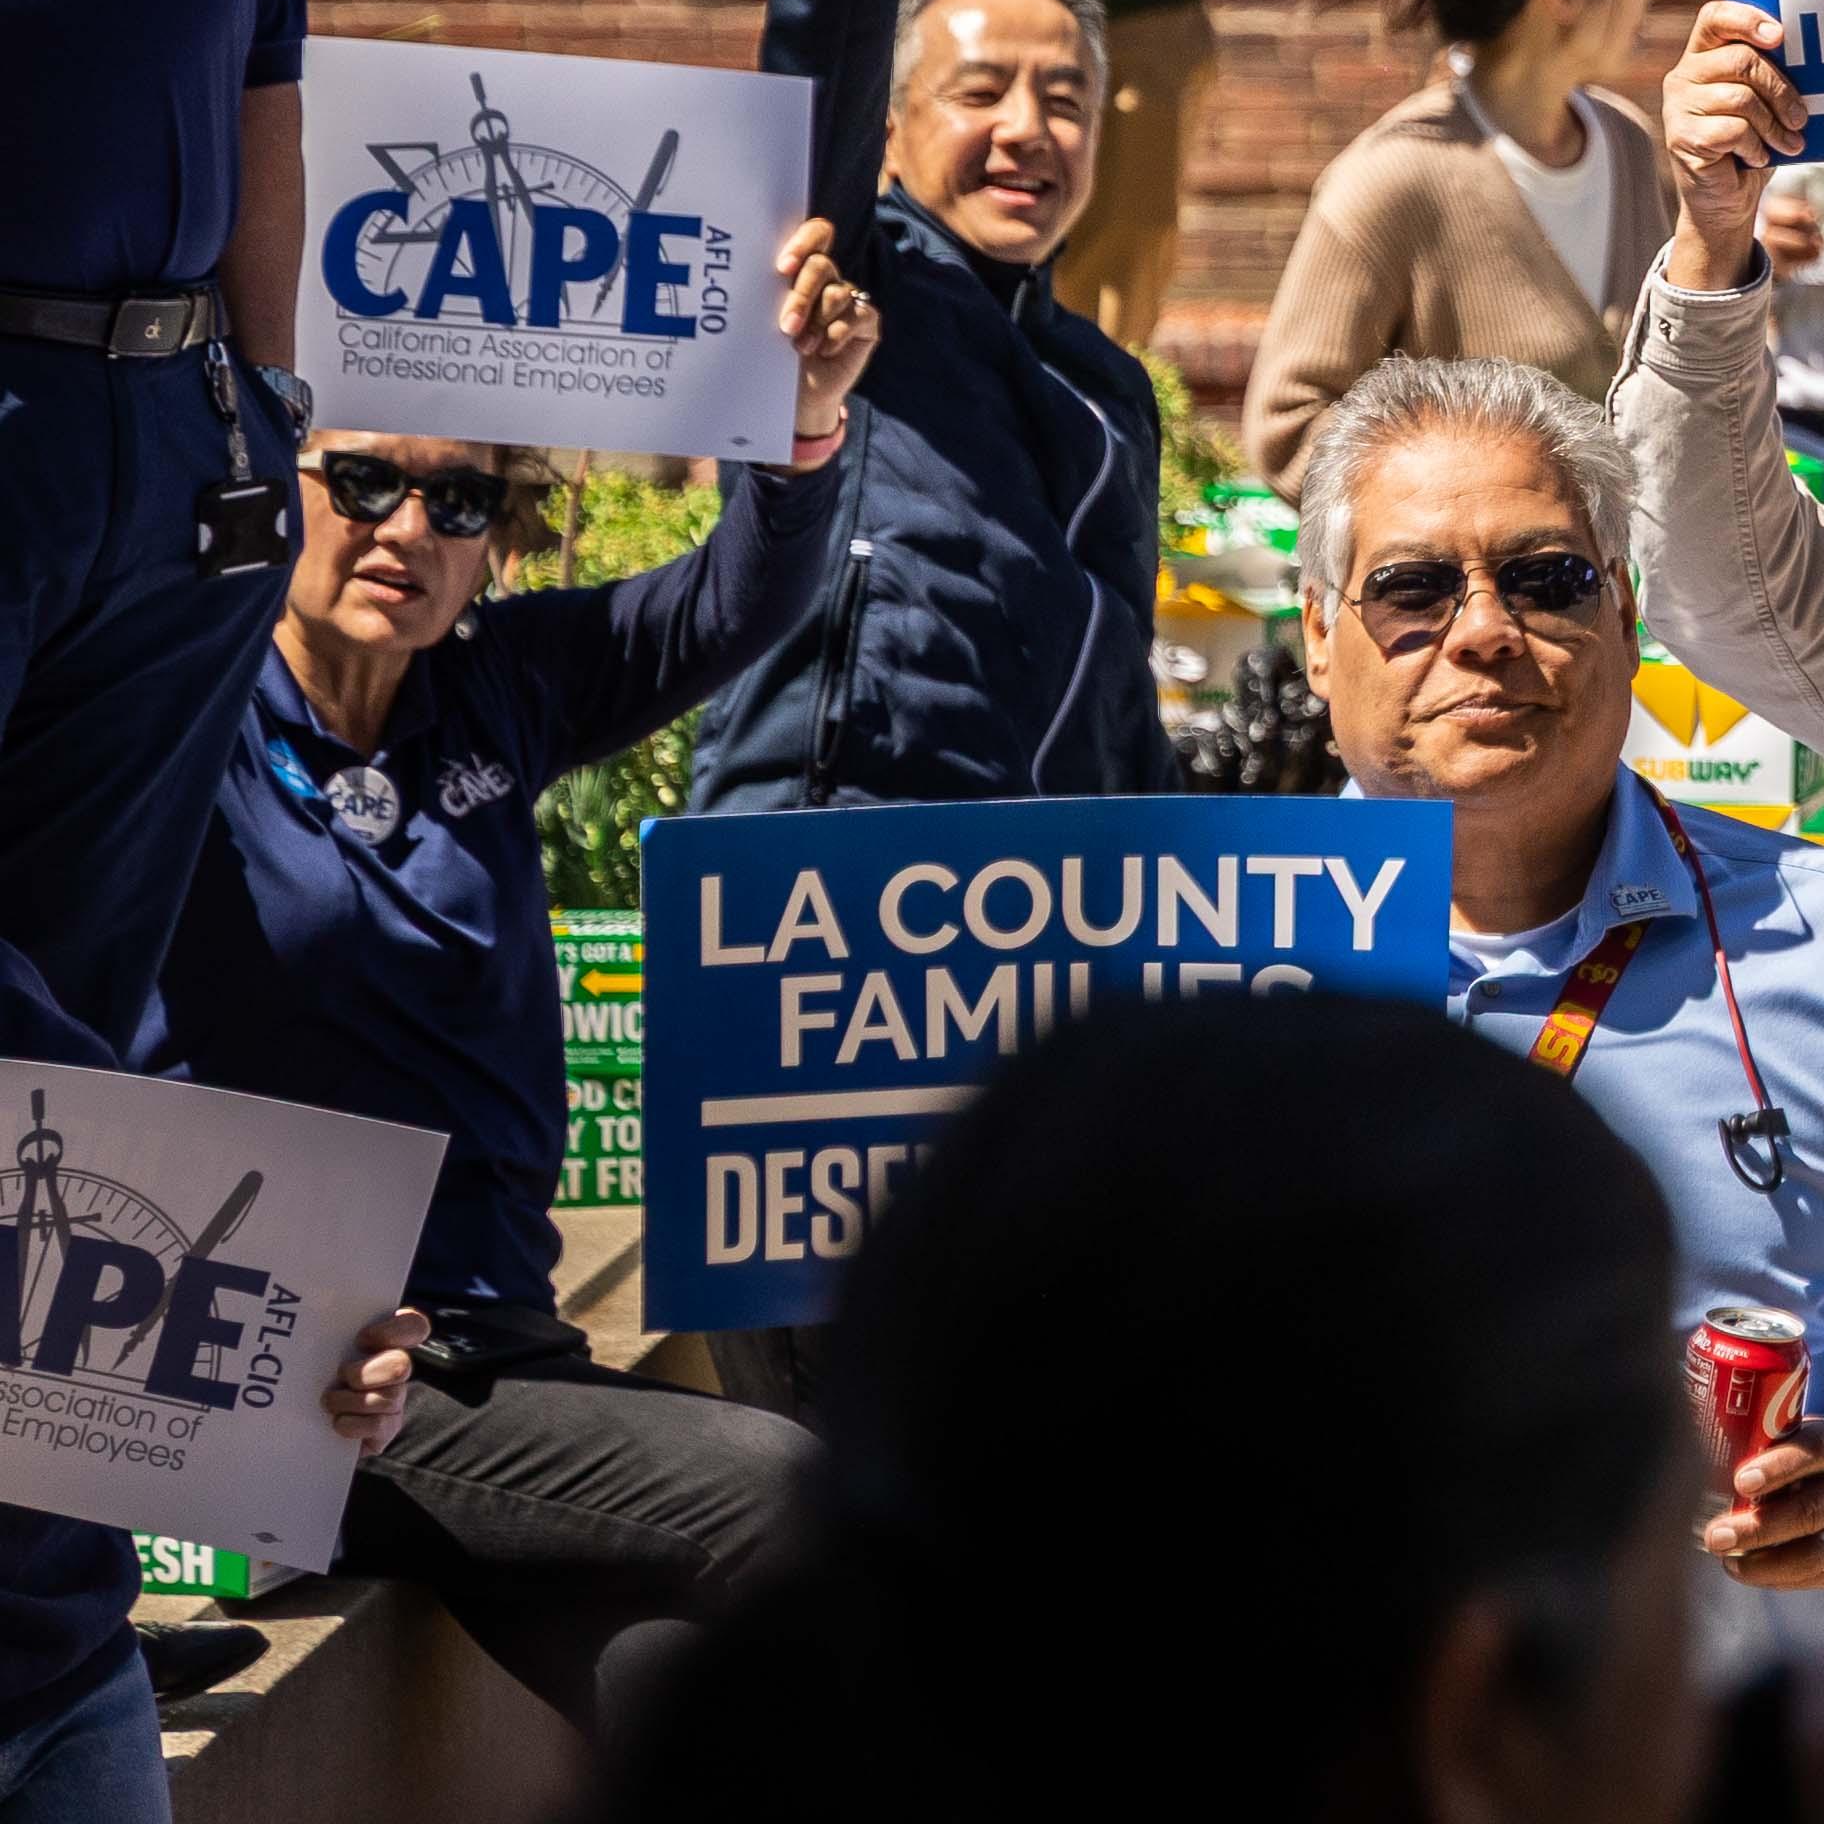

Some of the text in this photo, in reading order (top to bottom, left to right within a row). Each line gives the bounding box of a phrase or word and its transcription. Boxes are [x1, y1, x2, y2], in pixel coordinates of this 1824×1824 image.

[322, 190, 703, 339] CAPE
[705, 226, 733, 336] AFL-CIO
[337, 323, 674, 371] California Association of
[341, 341, 666, 396] Professional Employees
[1634, 758, 1758, 783] SUBWAY
[701, 854, 1405, 967] LA COUNTY
[1613, 889, 1660, 907] CAPE
[241, 1283, 301, 1409] AFL-CIO
[3, 1408, 186, 1471] Employees
[167, 1415, 205, 1442] of
[133, 1534, 215, 1586] ESH
